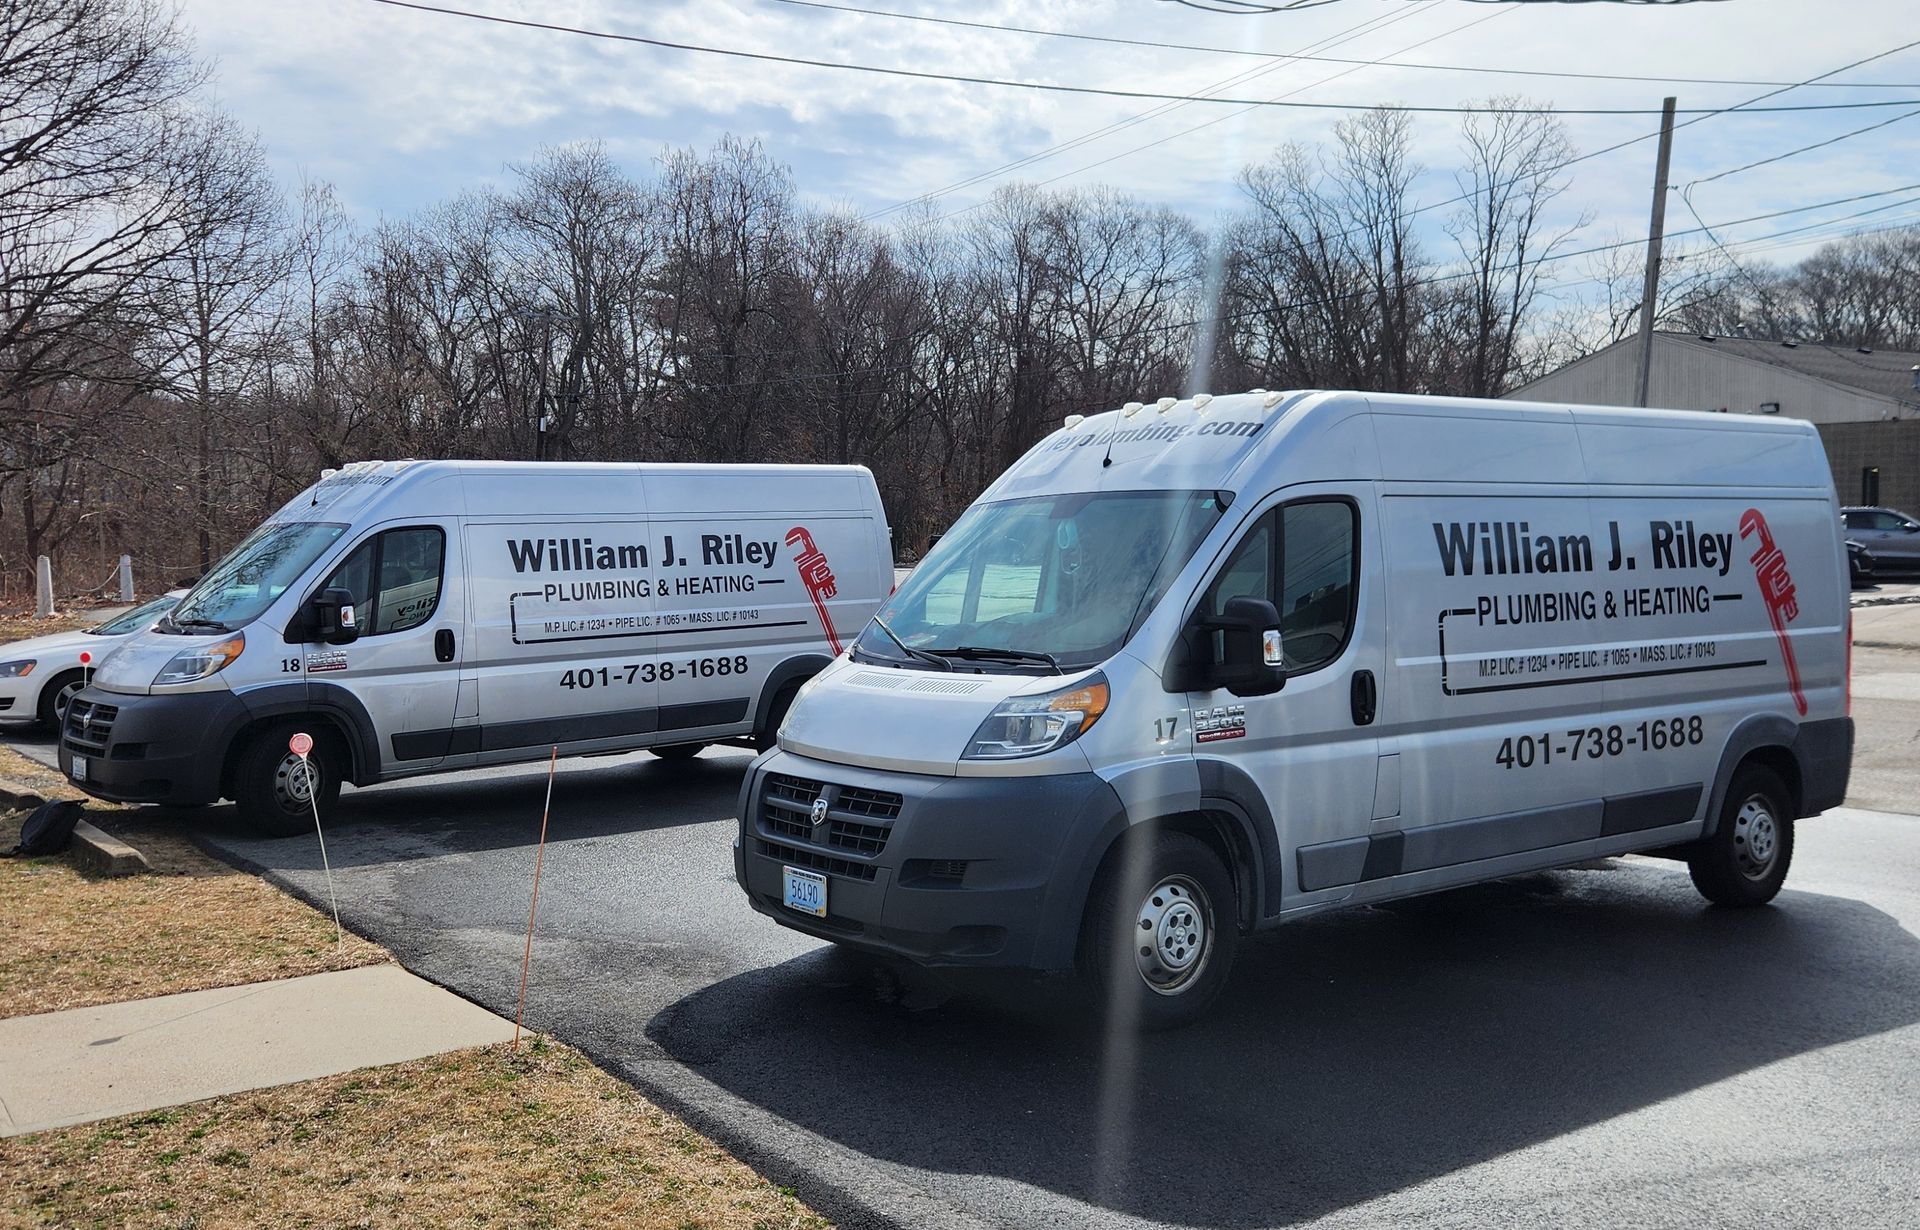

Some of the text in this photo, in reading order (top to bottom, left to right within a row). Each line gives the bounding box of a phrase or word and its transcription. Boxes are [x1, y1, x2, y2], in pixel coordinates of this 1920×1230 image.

[507, 534, 778, 573] William J. Riley
[1432, 519, 1733, 577] William J. Riley
[544, 575, 754, 603] PLUMBING & HEATING
[1477, 585, 1710, 626] PLUMBING & HEATING
[544, 622, 560, 633] M.P.
[587, 619, 605, 630] 1234
[615, 617, 634, 628] PIPE
[637, 616, 653, 627] LIC.
[663, 614, 680, 625] 1065
[689, 612, 715, 623] MASS.
[740, 609, 759, 620] 10143
[281, 658, 300, 672] 18
[559, 655, 749, 690] 401-738-1688
[1479, 659, 1496, 677] M.P.
[1527, 655, 1547, 672] 1234
[1559, 652, 1580, 670] PIPE
[1583, 650, 1600, 668] LIC.
[1611, 648, 1630, 665] 1065
[1640, 645, 1668, 663] MASS.
[1694, 641, 1716, 658] 10143
[1154, 716, 1178, 742] 17
[1495, 714, 1704, 770] 401-738-1688
[791, 879, 818, 904] 56190
